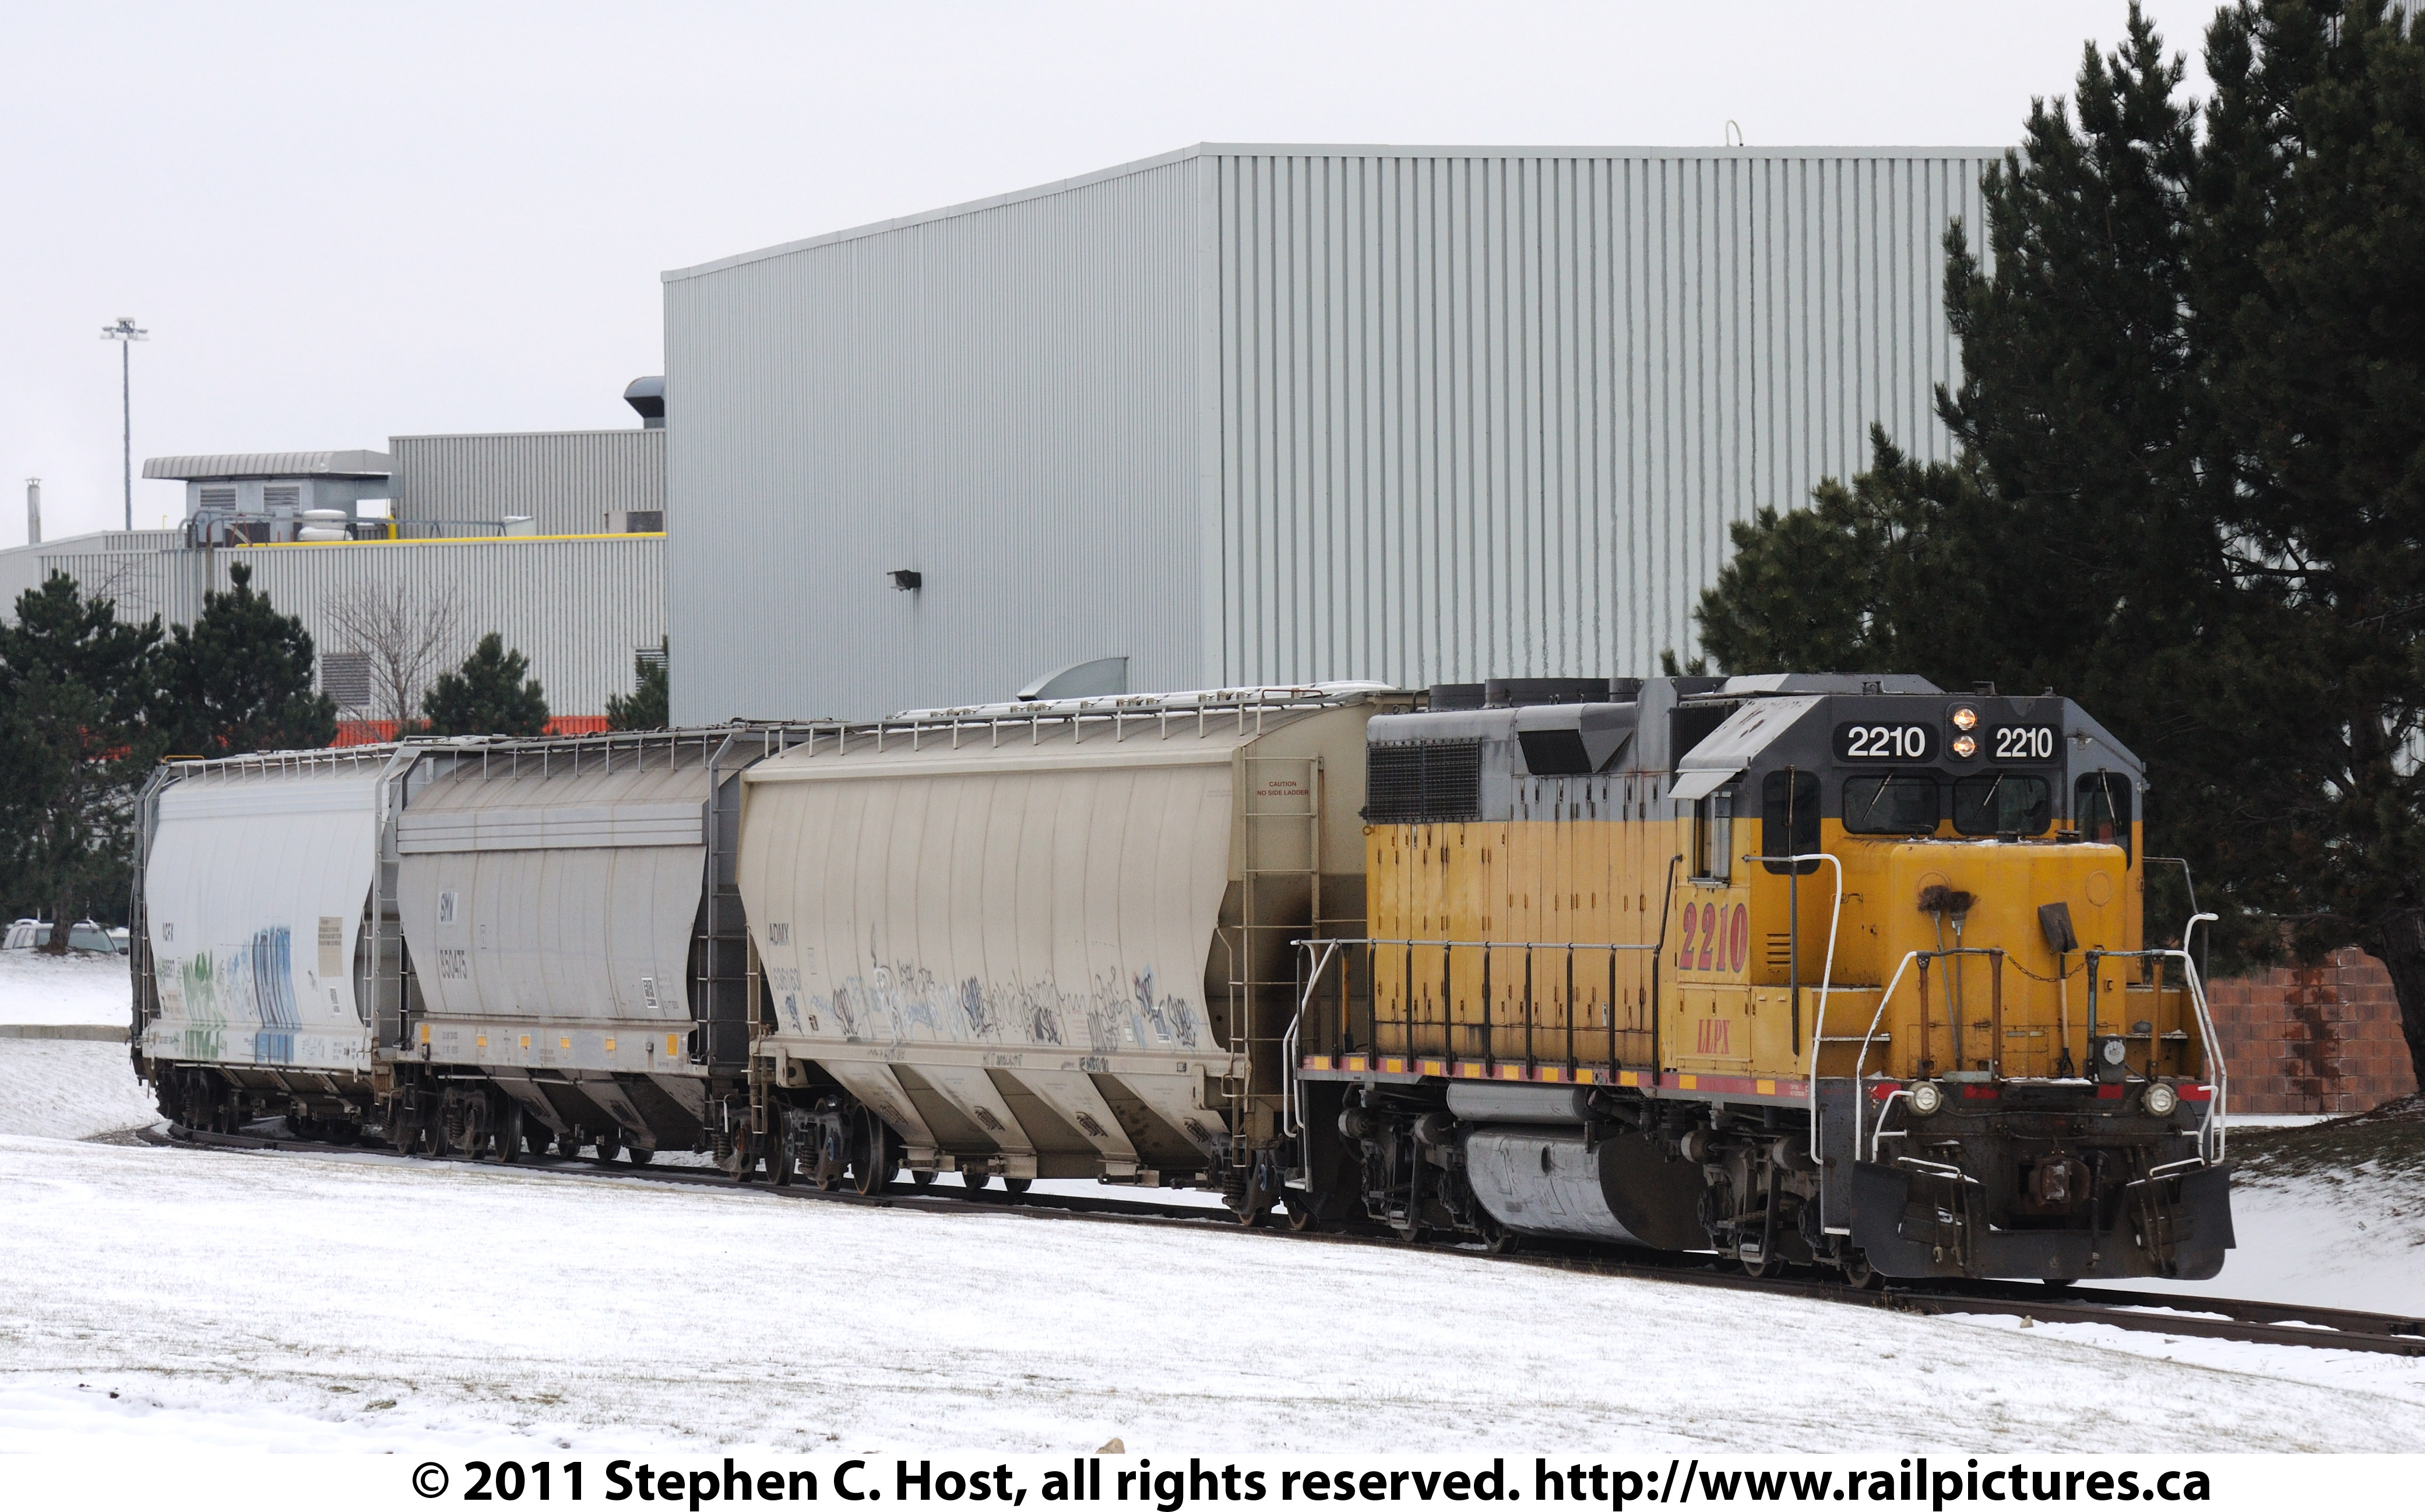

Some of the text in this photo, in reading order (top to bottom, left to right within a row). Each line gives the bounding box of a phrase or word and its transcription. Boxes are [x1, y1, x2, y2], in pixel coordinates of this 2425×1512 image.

[1847, 726, 1926, 757] 2210
[1995, 727, 2053, 758] 2210
[769, 922, 790, 946] ADMX
[1678, 901, 1748, 973] 2210
[439, 949, 467, 980] 850475
[773, 967, 801, 992] 636163
[1697, 1019, 1731, 1055] LLPX
